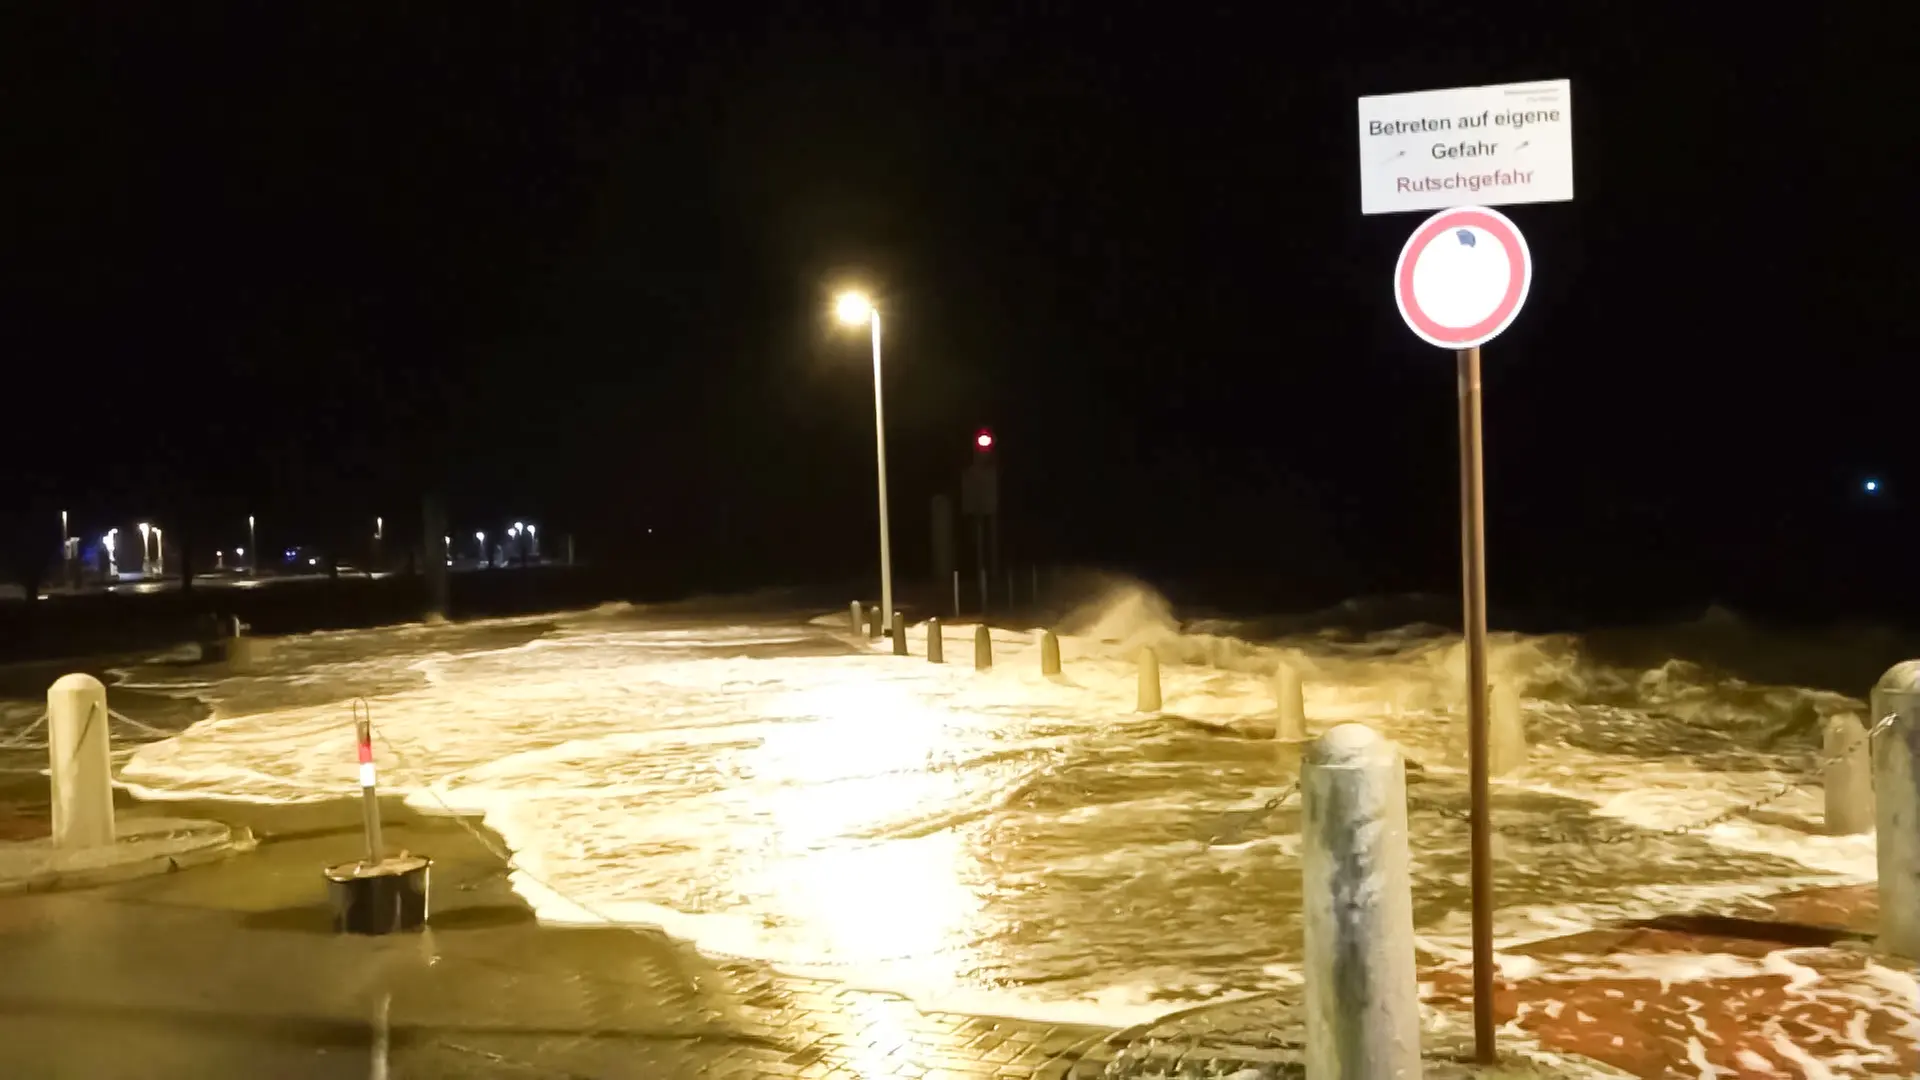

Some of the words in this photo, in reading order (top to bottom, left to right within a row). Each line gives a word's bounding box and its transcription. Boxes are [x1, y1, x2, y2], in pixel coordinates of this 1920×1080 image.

[1369, 117, 1451, 136] Betreten
[1458, 110, 1490, 129] auf
[1495, 108, 1560, 129] eigene
[1431, 141, 1499, 160] Gefahr
[1397, 169, 1535, 194] Rutschgefahr
